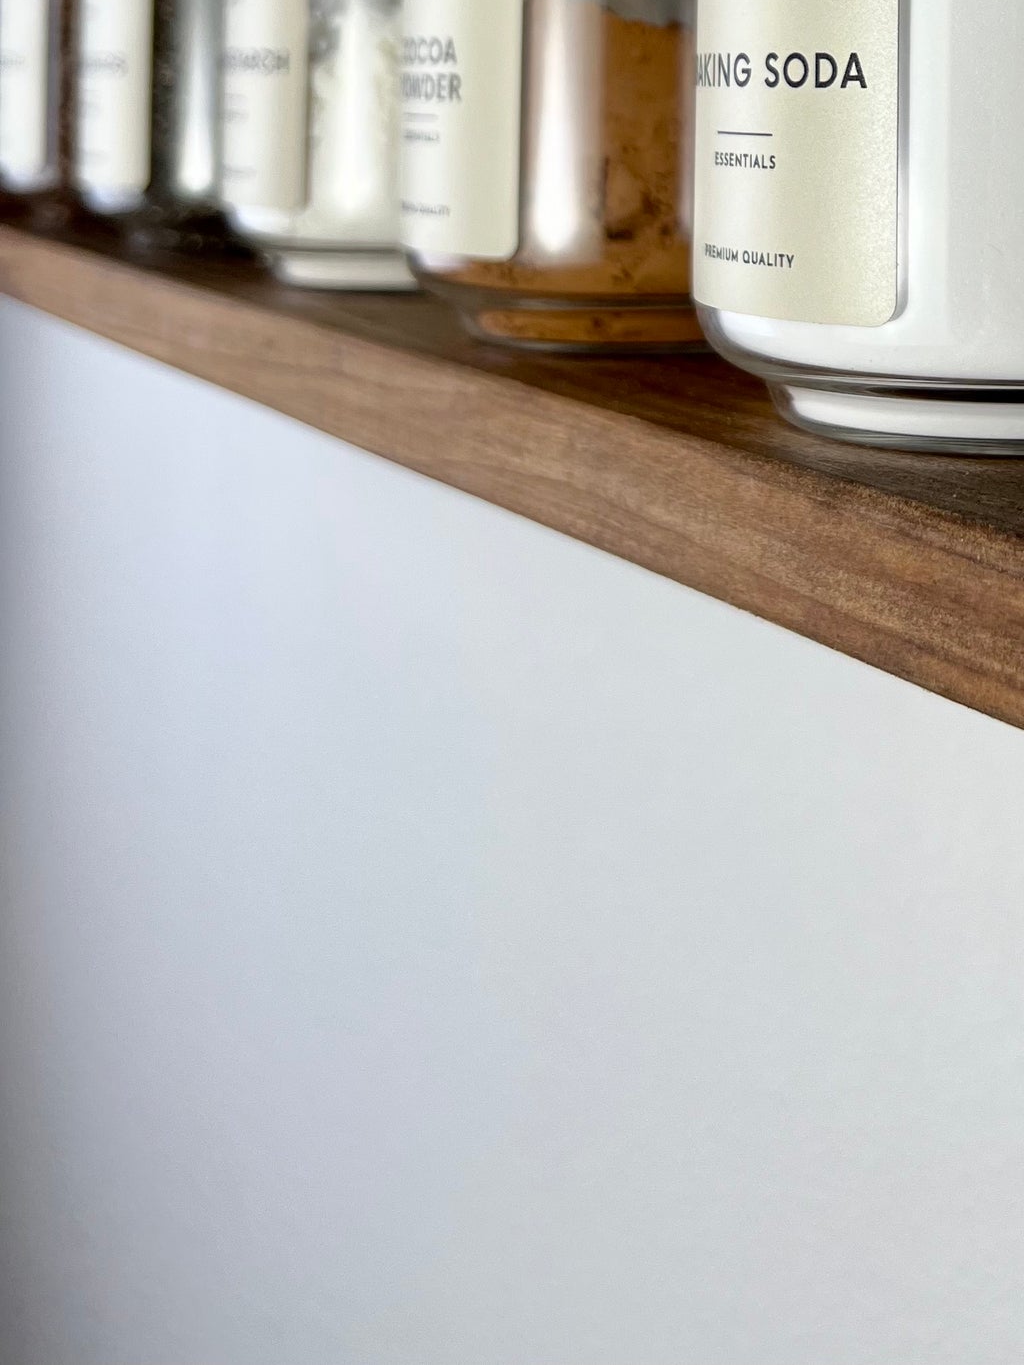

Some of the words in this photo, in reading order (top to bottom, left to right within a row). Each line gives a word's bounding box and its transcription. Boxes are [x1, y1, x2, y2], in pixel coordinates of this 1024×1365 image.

[695, 51, 752, 88] AKING
[764, 52, 868, 89] SODA
[714, 151, 776, 169] ESSENTIALS
[704, 242, 739, 263] PREMIUM
[742, 250, 794, 268] QUALITY
